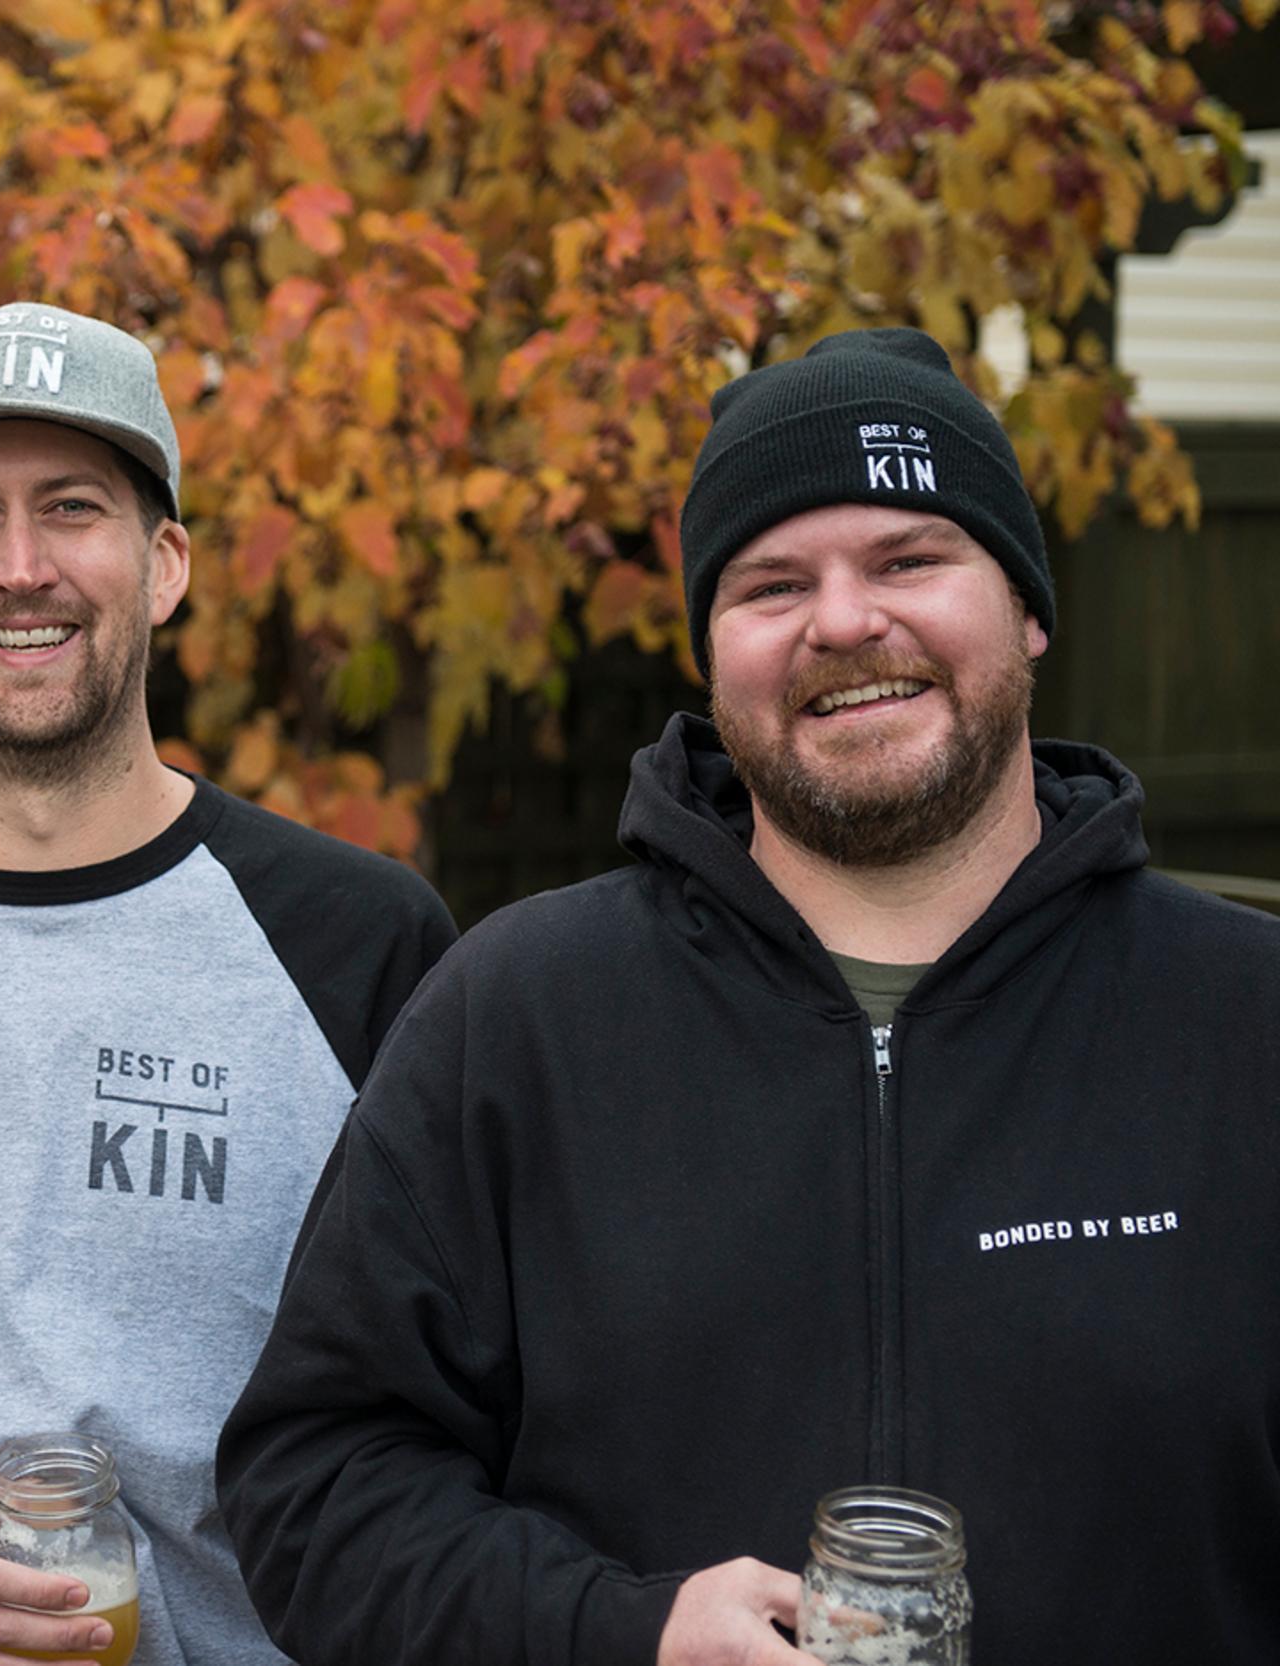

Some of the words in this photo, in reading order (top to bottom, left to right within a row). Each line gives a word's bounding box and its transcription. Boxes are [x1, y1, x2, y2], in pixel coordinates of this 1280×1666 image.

[40, 315, 71, 332] OF
[859, 424, 900, 438] BEST
[907, 426, 927, 441] OF
[867, 455, 936, 492] KIN
[97, 1048, 175, 1082] BEST
[192, 1062, 228, 1090] OF
[88, 1121, 227, 1204] KIN
[979, 1220, 1073, 1251] BONDED
[1082, 1219, 1110, 1238] BY
[1121, 1211, 1179, 1235] BEER
